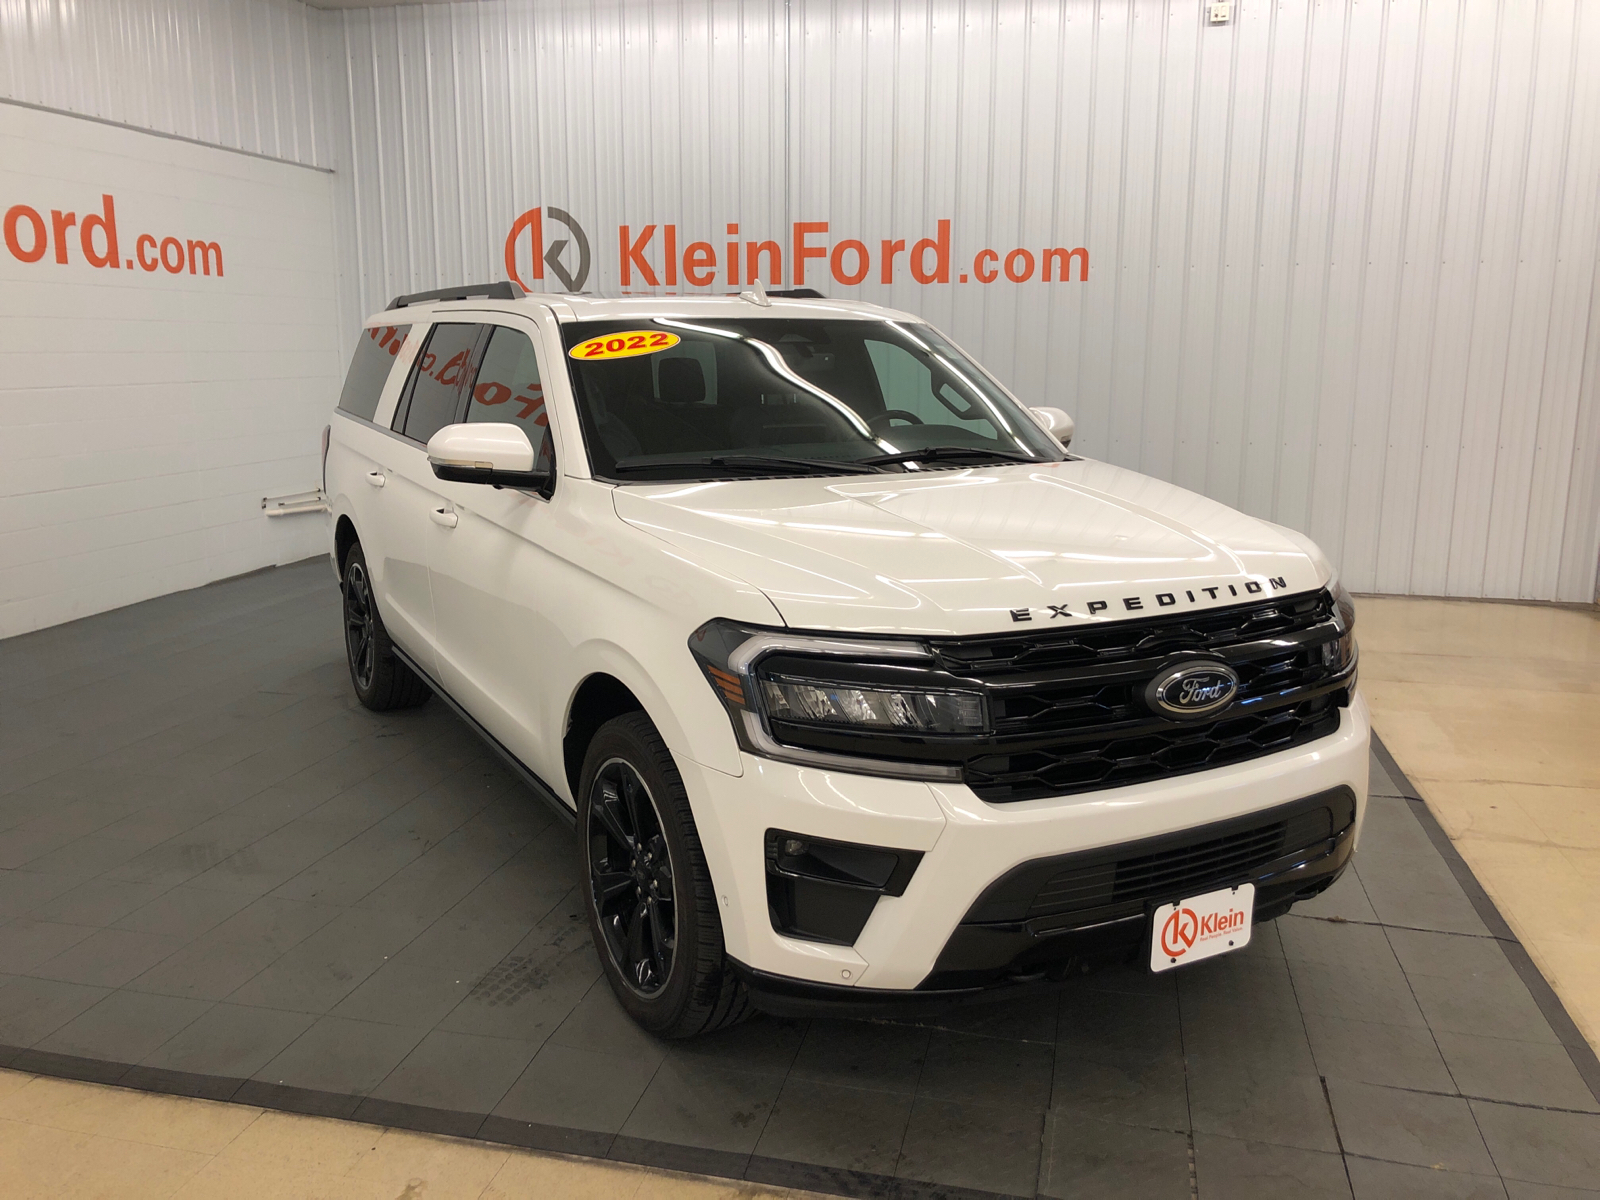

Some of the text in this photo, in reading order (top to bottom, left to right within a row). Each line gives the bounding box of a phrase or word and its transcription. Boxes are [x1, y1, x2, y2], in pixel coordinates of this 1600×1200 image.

[3, 194, 224, 277] ord.com
[619, 218, 1089, 287] KleinFord.com
[584, 333, 669, 357] 2022
[1010, 576, 1287, 622] EXPEDITION
[1179, 676, 1222, 704] Ford
[1200, 908, 1244, 936] Klein
